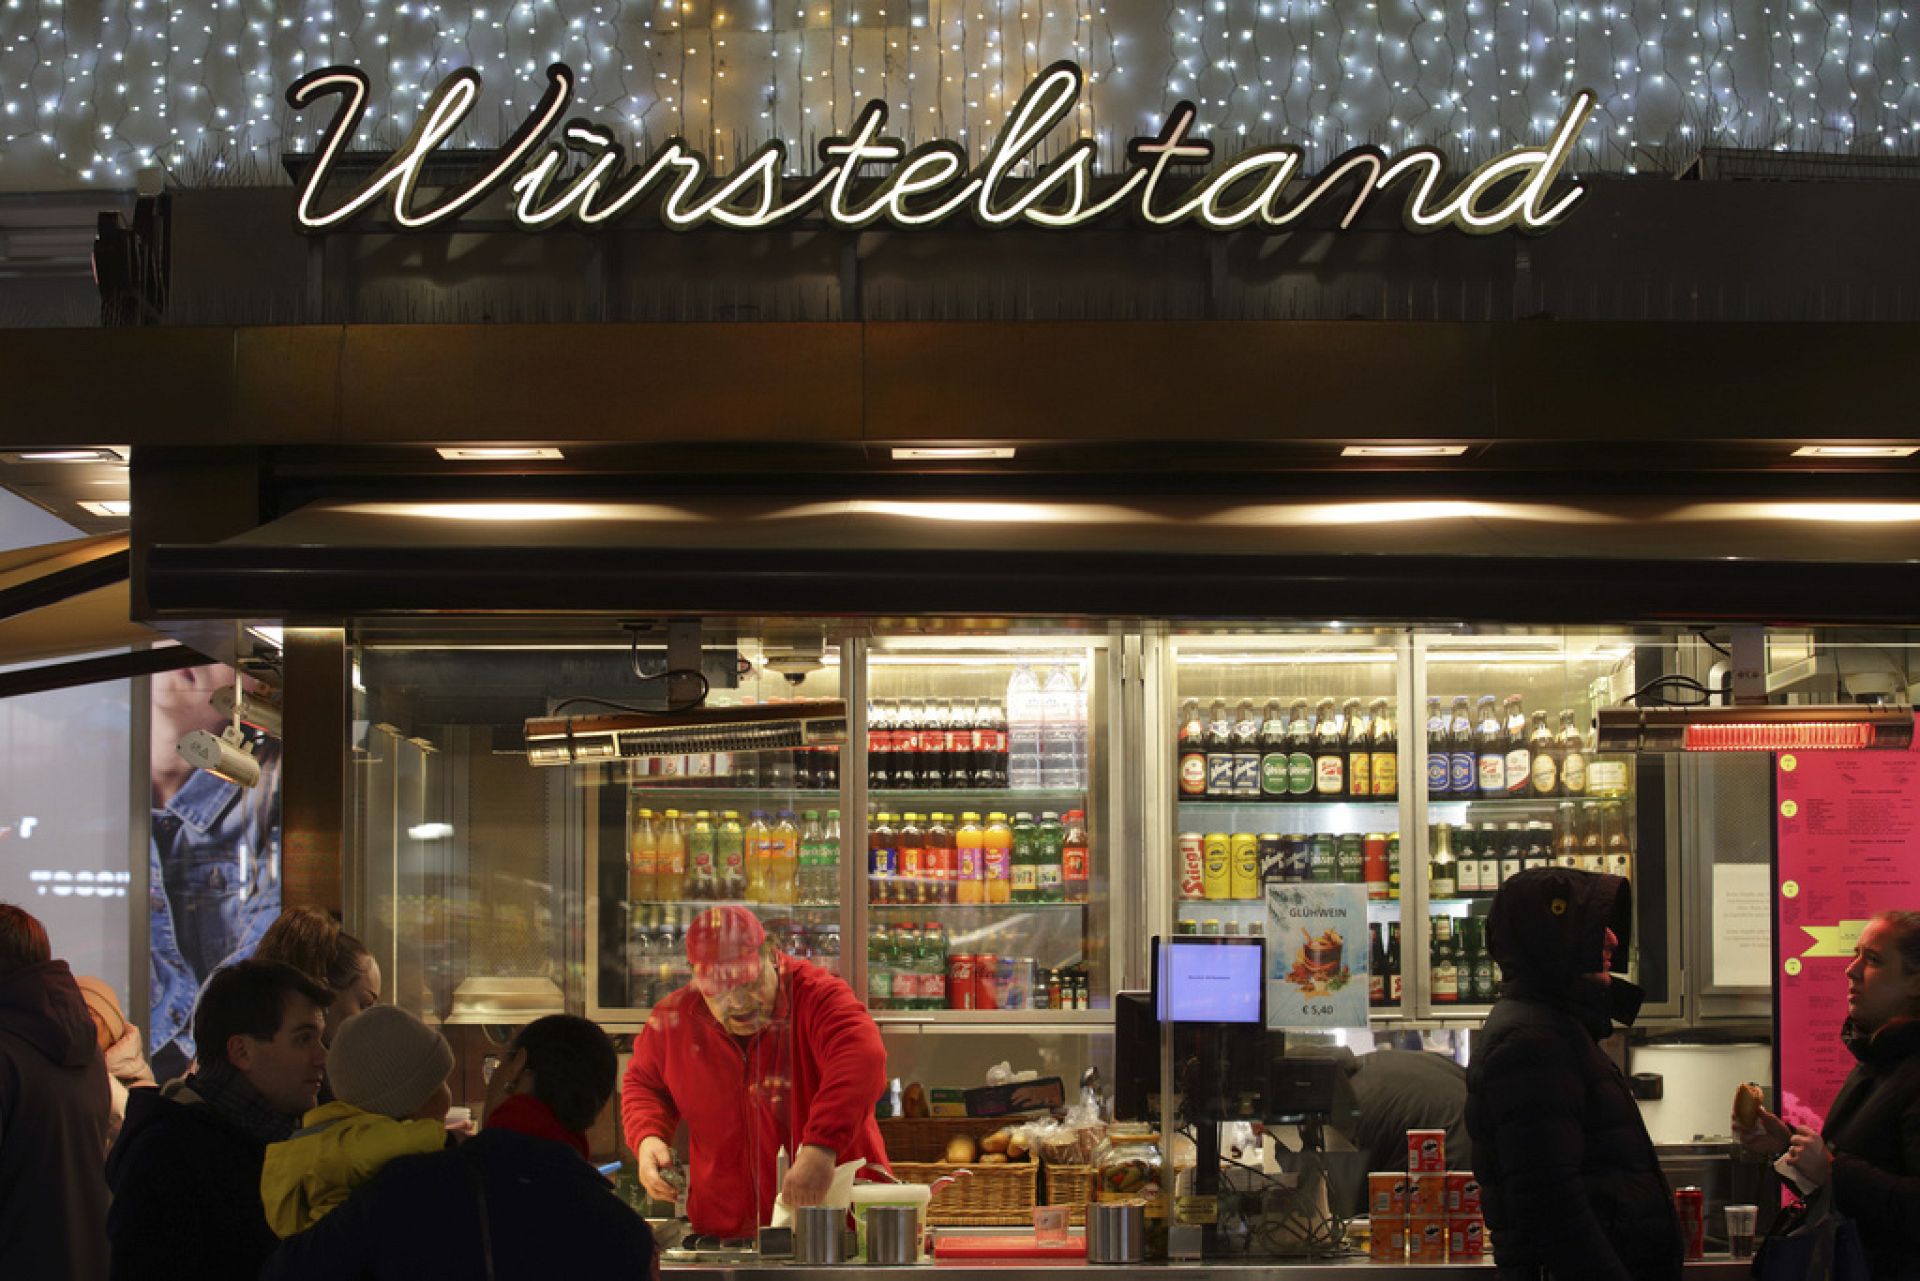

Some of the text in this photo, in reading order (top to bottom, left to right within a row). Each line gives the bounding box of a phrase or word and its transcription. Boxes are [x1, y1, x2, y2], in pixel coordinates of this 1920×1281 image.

[286, 60, 1597, 234] Würstelstand
[1290, 905, 1347, 918] GLÜHWEIN
[1311, 1004, 1334, 1016] 5,40
